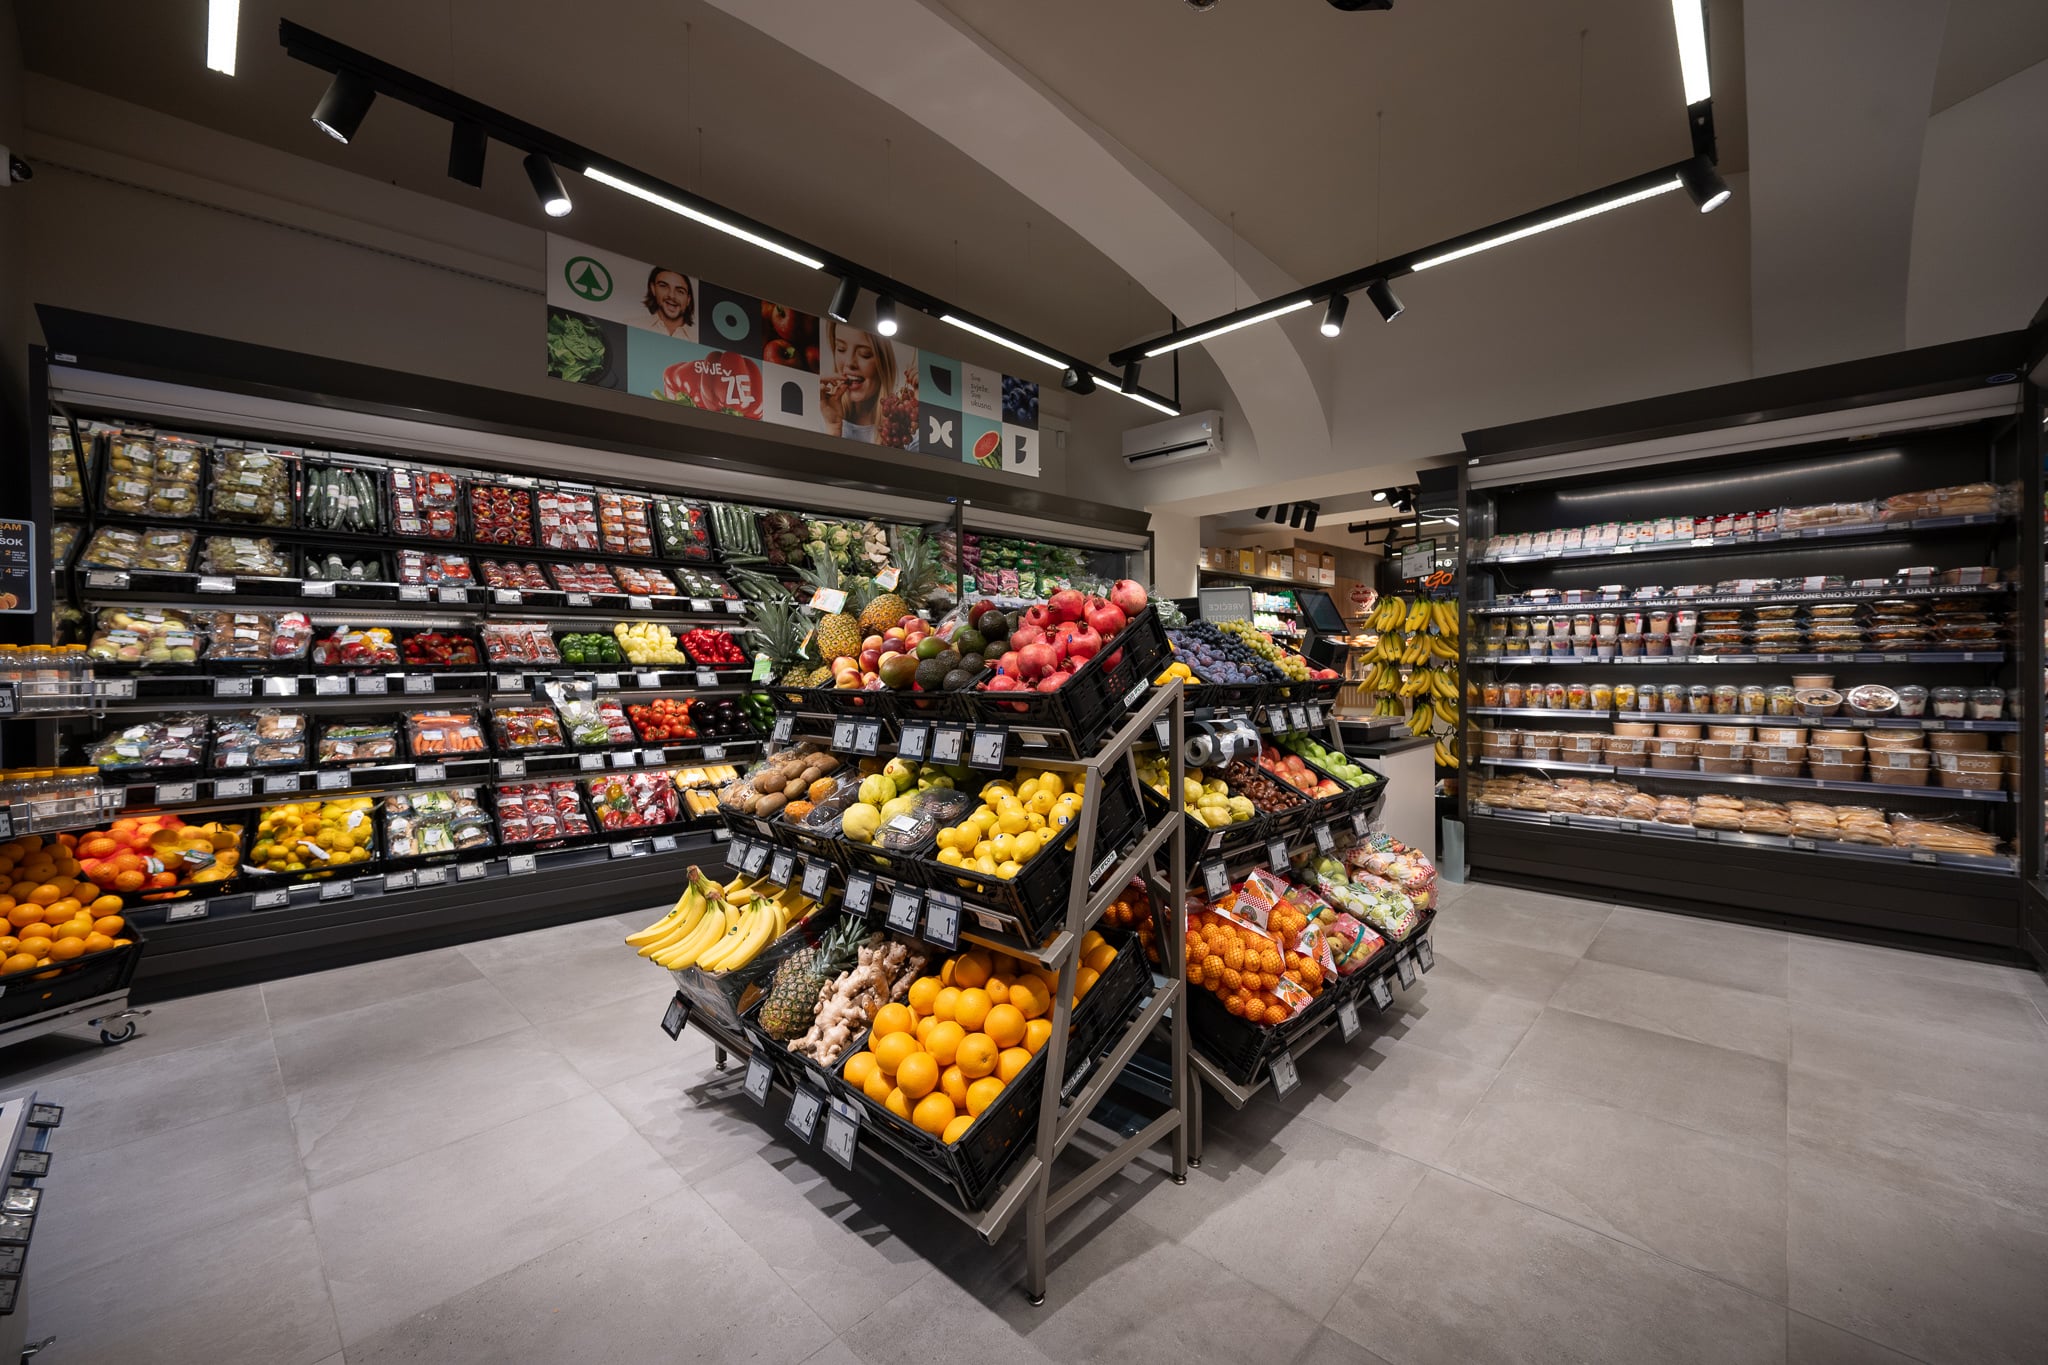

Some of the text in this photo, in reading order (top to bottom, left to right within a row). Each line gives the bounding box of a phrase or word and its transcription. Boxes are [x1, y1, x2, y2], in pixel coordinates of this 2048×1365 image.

[694, 361, 723, 376] SVJE
[1721, 596, 1750, 604] FRESH
[1771, 591, 1841, 602] SVAKODNEVNO
[1906, 586, 1936, 596] DAILY
[1939, 585, 1977, 594] FRESH
